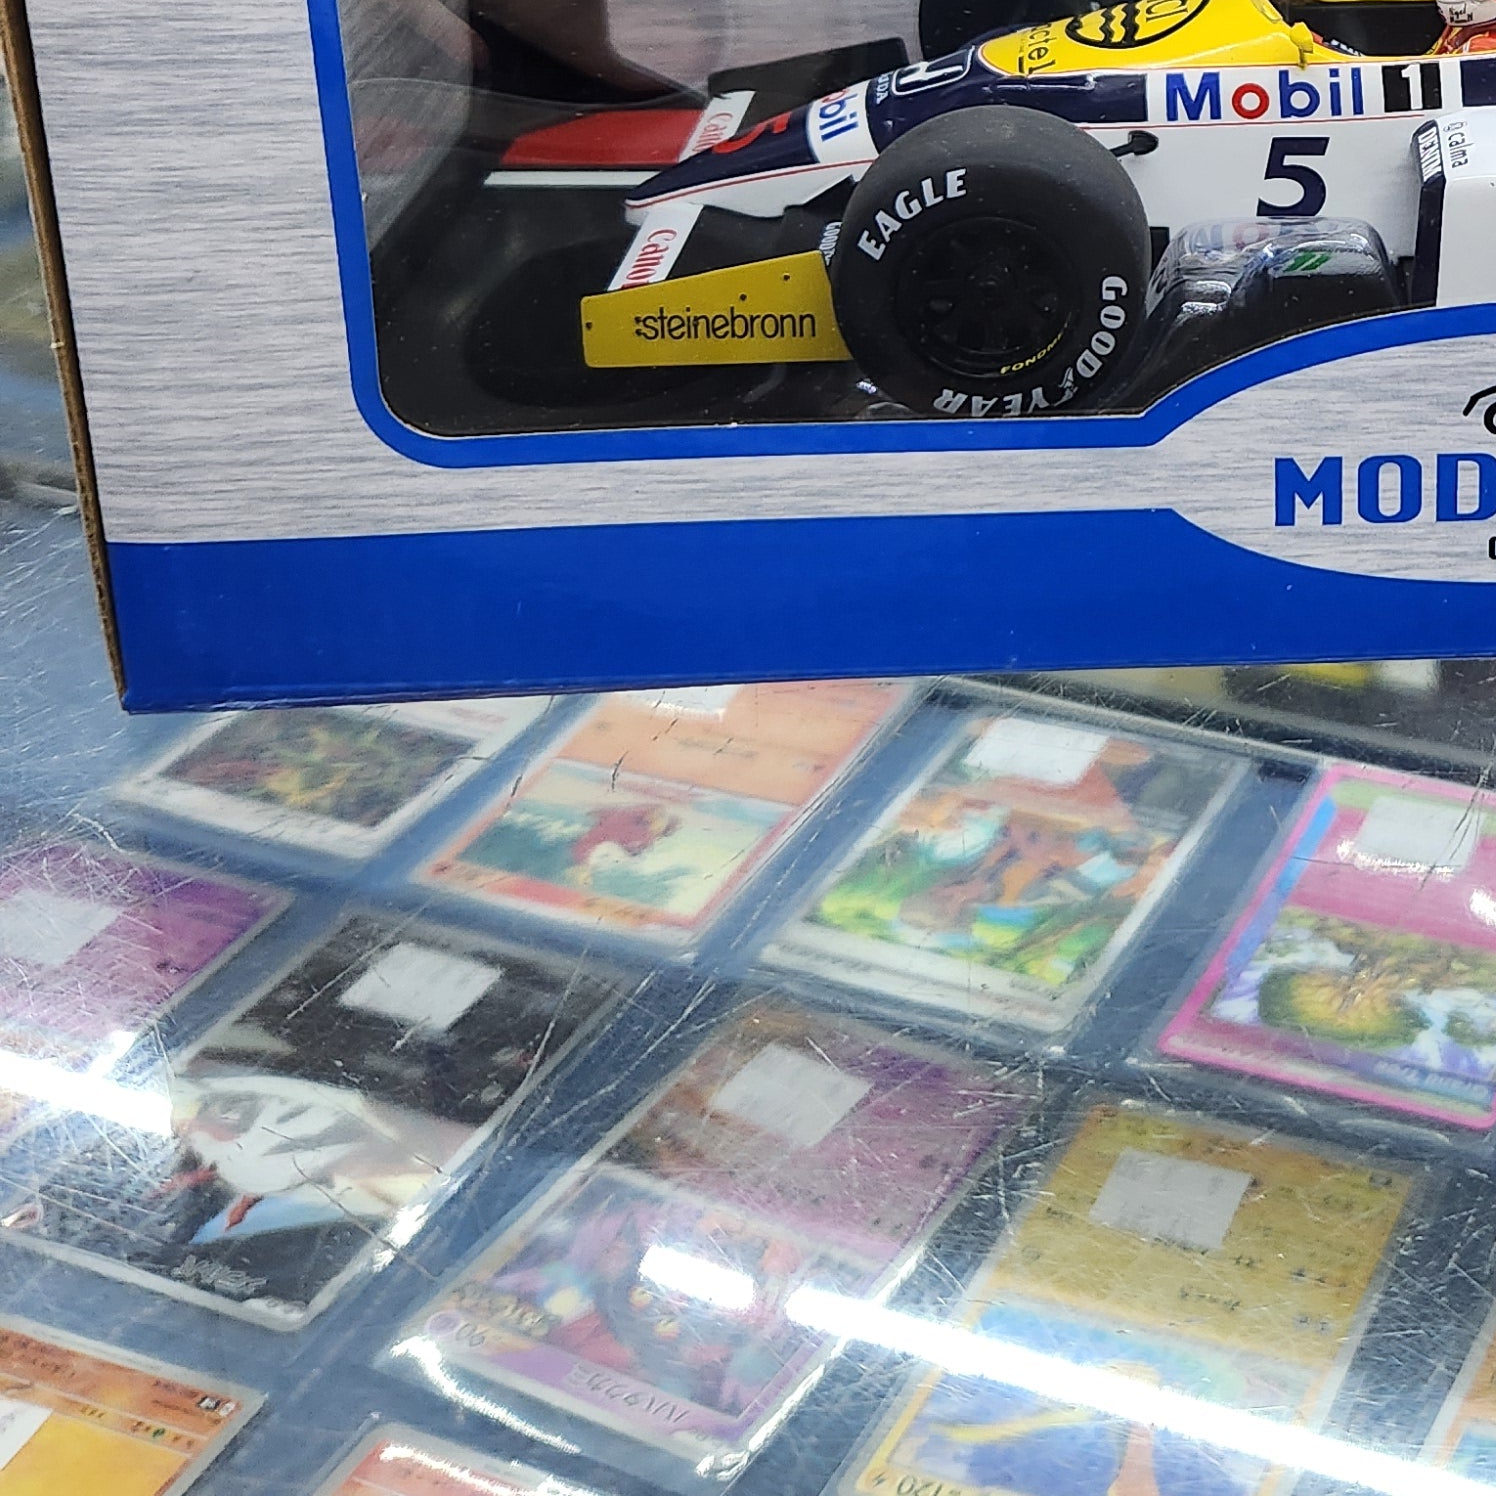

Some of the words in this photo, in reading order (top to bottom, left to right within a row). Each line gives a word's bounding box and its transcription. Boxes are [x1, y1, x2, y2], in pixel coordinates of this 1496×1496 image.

[1166, 67, 1364, 121] Mobil
[1401, 64, 1423, 110] 1
[1256, 137, 1330, 216] 5
[1418, 126, 1442, 182] DENIM
[857, 168, 967, 261] EAGLE
[641, 306, 816, 339] steinebronn
